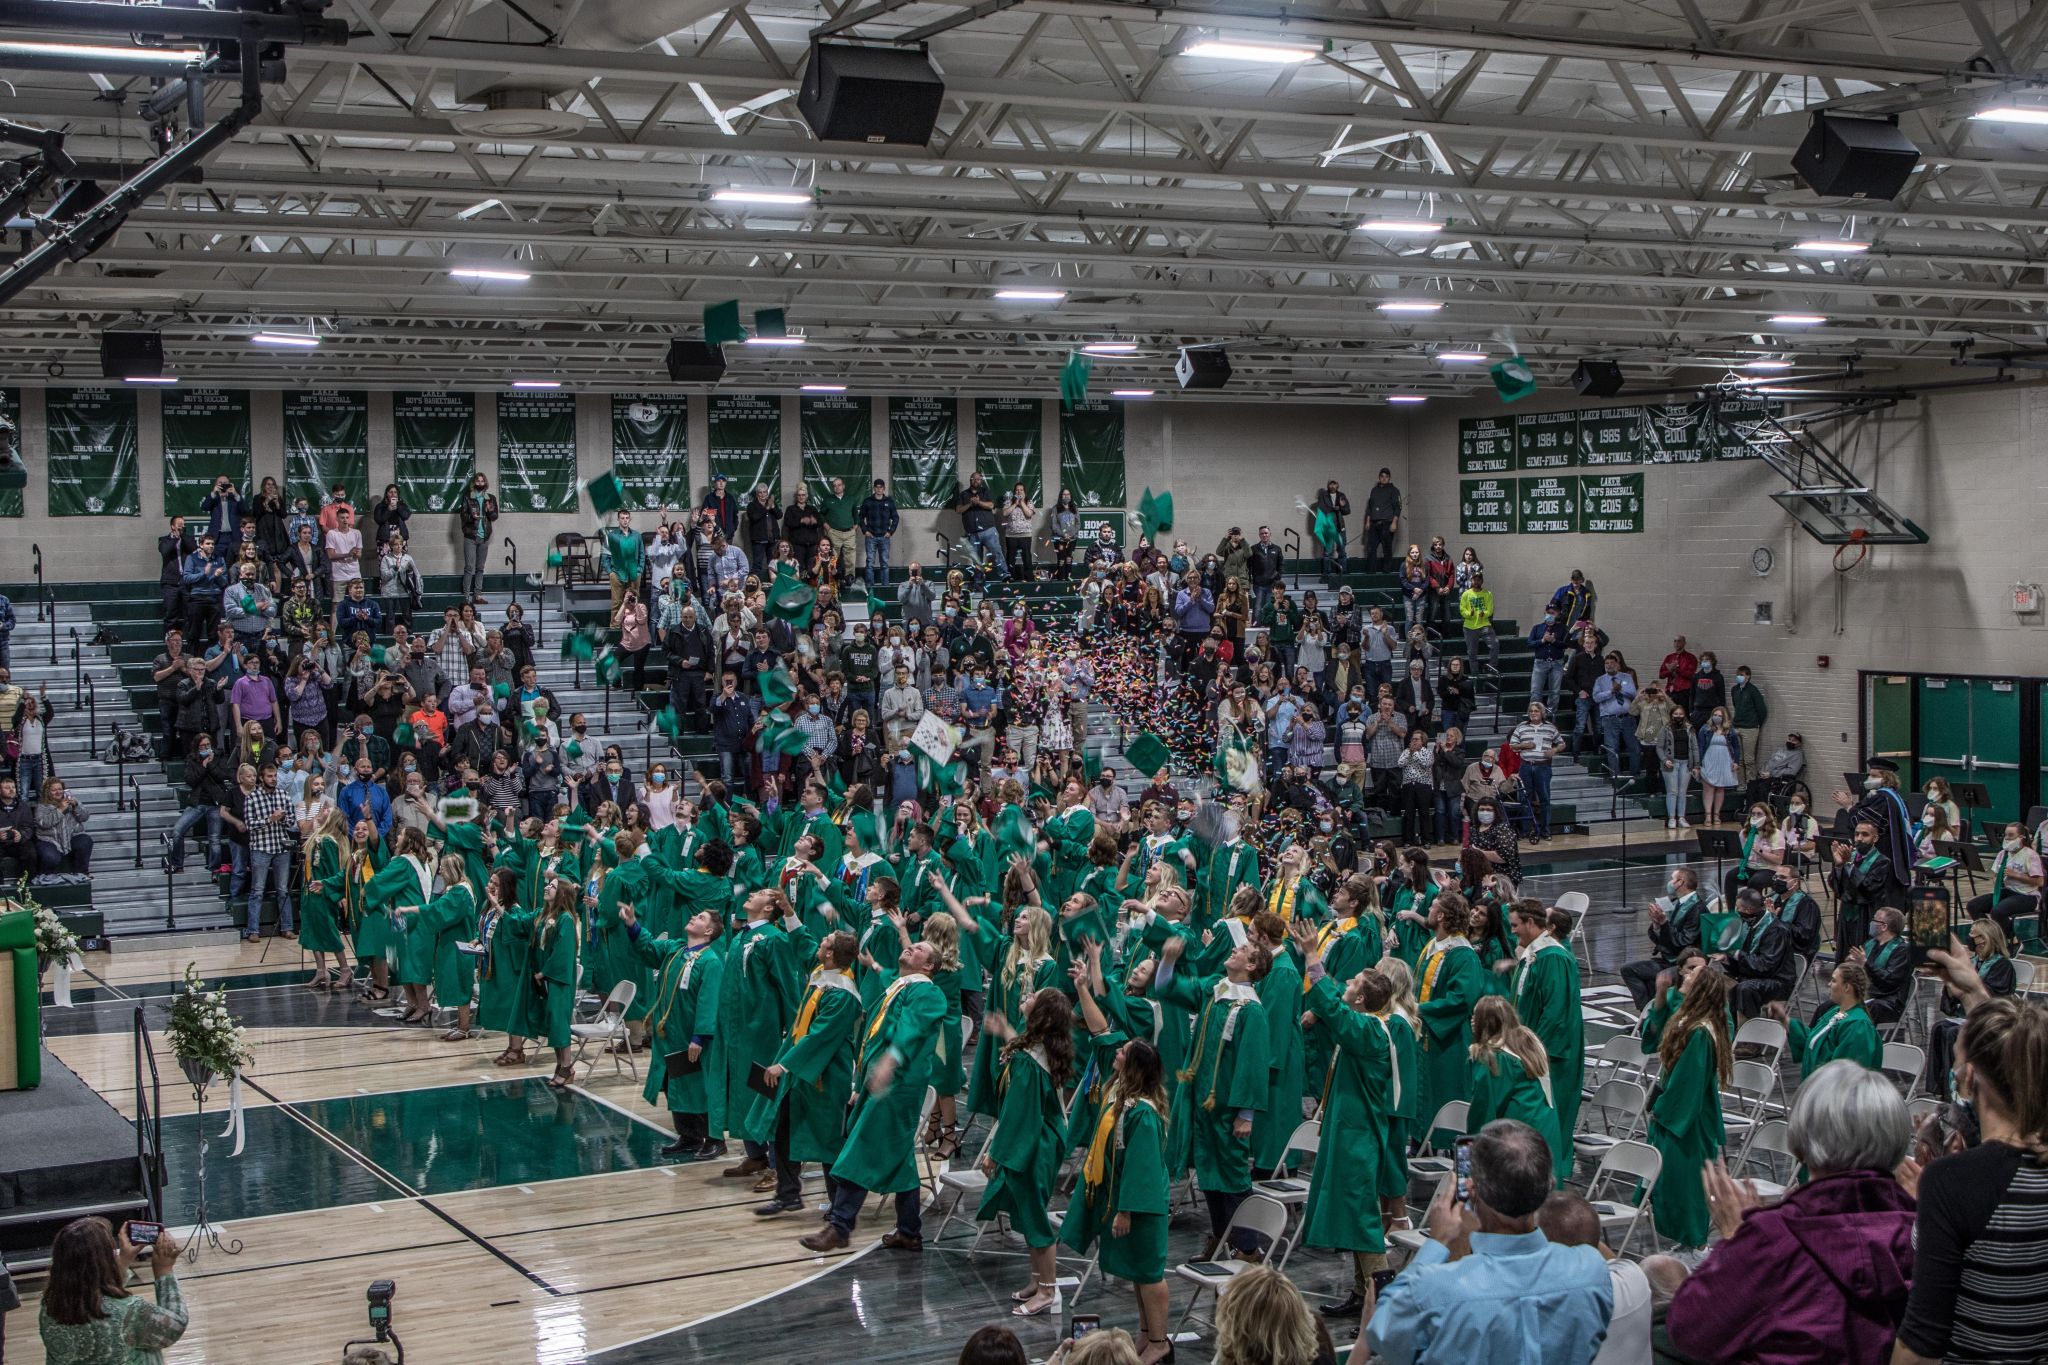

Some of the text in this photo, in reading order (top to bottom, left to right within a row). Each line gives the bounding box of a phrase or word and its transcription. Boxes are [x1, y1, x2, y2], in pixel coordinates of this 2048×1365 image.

[424, 397, 463, 405] BASKETBALL
[1720, 401, 1741, 412] AKER
[1580, 407, 1642, 421] LAKER VOLLEYBALL
[1665, 406, 1688, 416] LAKER
[1518, 411, 1576, 425] LAKER VOLLEYBALL
[1476, 420, 1496, 430] LAKER
[1478, 428, 1512, 439] BASKETBALL
[1599, 428, 1620, 443] 1985
[1664, 429, 1687, 444] 2001
[1537, 433, 1557, 447] 1984
[1476, 440, 1495, 454] 1972
[1526, 455, 1568, 467] SEMI-FINALS
[1588, 451, 1632, 464] SEMI-FINALS
[1654, 449, 1702, 462] SEMI-FINALS
[1467, 459, 1508, 471] SEMI-FINALS
[1479, 481, 1498, 490] LAKER
[1538, 479, 1558, 488] LAKER
[1600, 477, 1621, 487] LAKER
[1486, 490, 1505, 498] SOCCER
[1545, 487, 1566, 497] SOCCER
[1605, 486, 1635, 496] BASEBALL
[1477, 502, 1499, 516] 2002
[1537, 500, 1559, 515] 2005
[1600, 499, 1622, 513] 2015
[1084, 520, 1109, 530] HOM
[1468, 522, 1508, 532] SEMI-FINALS
[1527, 520, 1569, 531] SEMI-FINALS
[1589, 519, 1633, 531] SEMI-FINALS
[1078, 530, 1116, 539] SEATG
